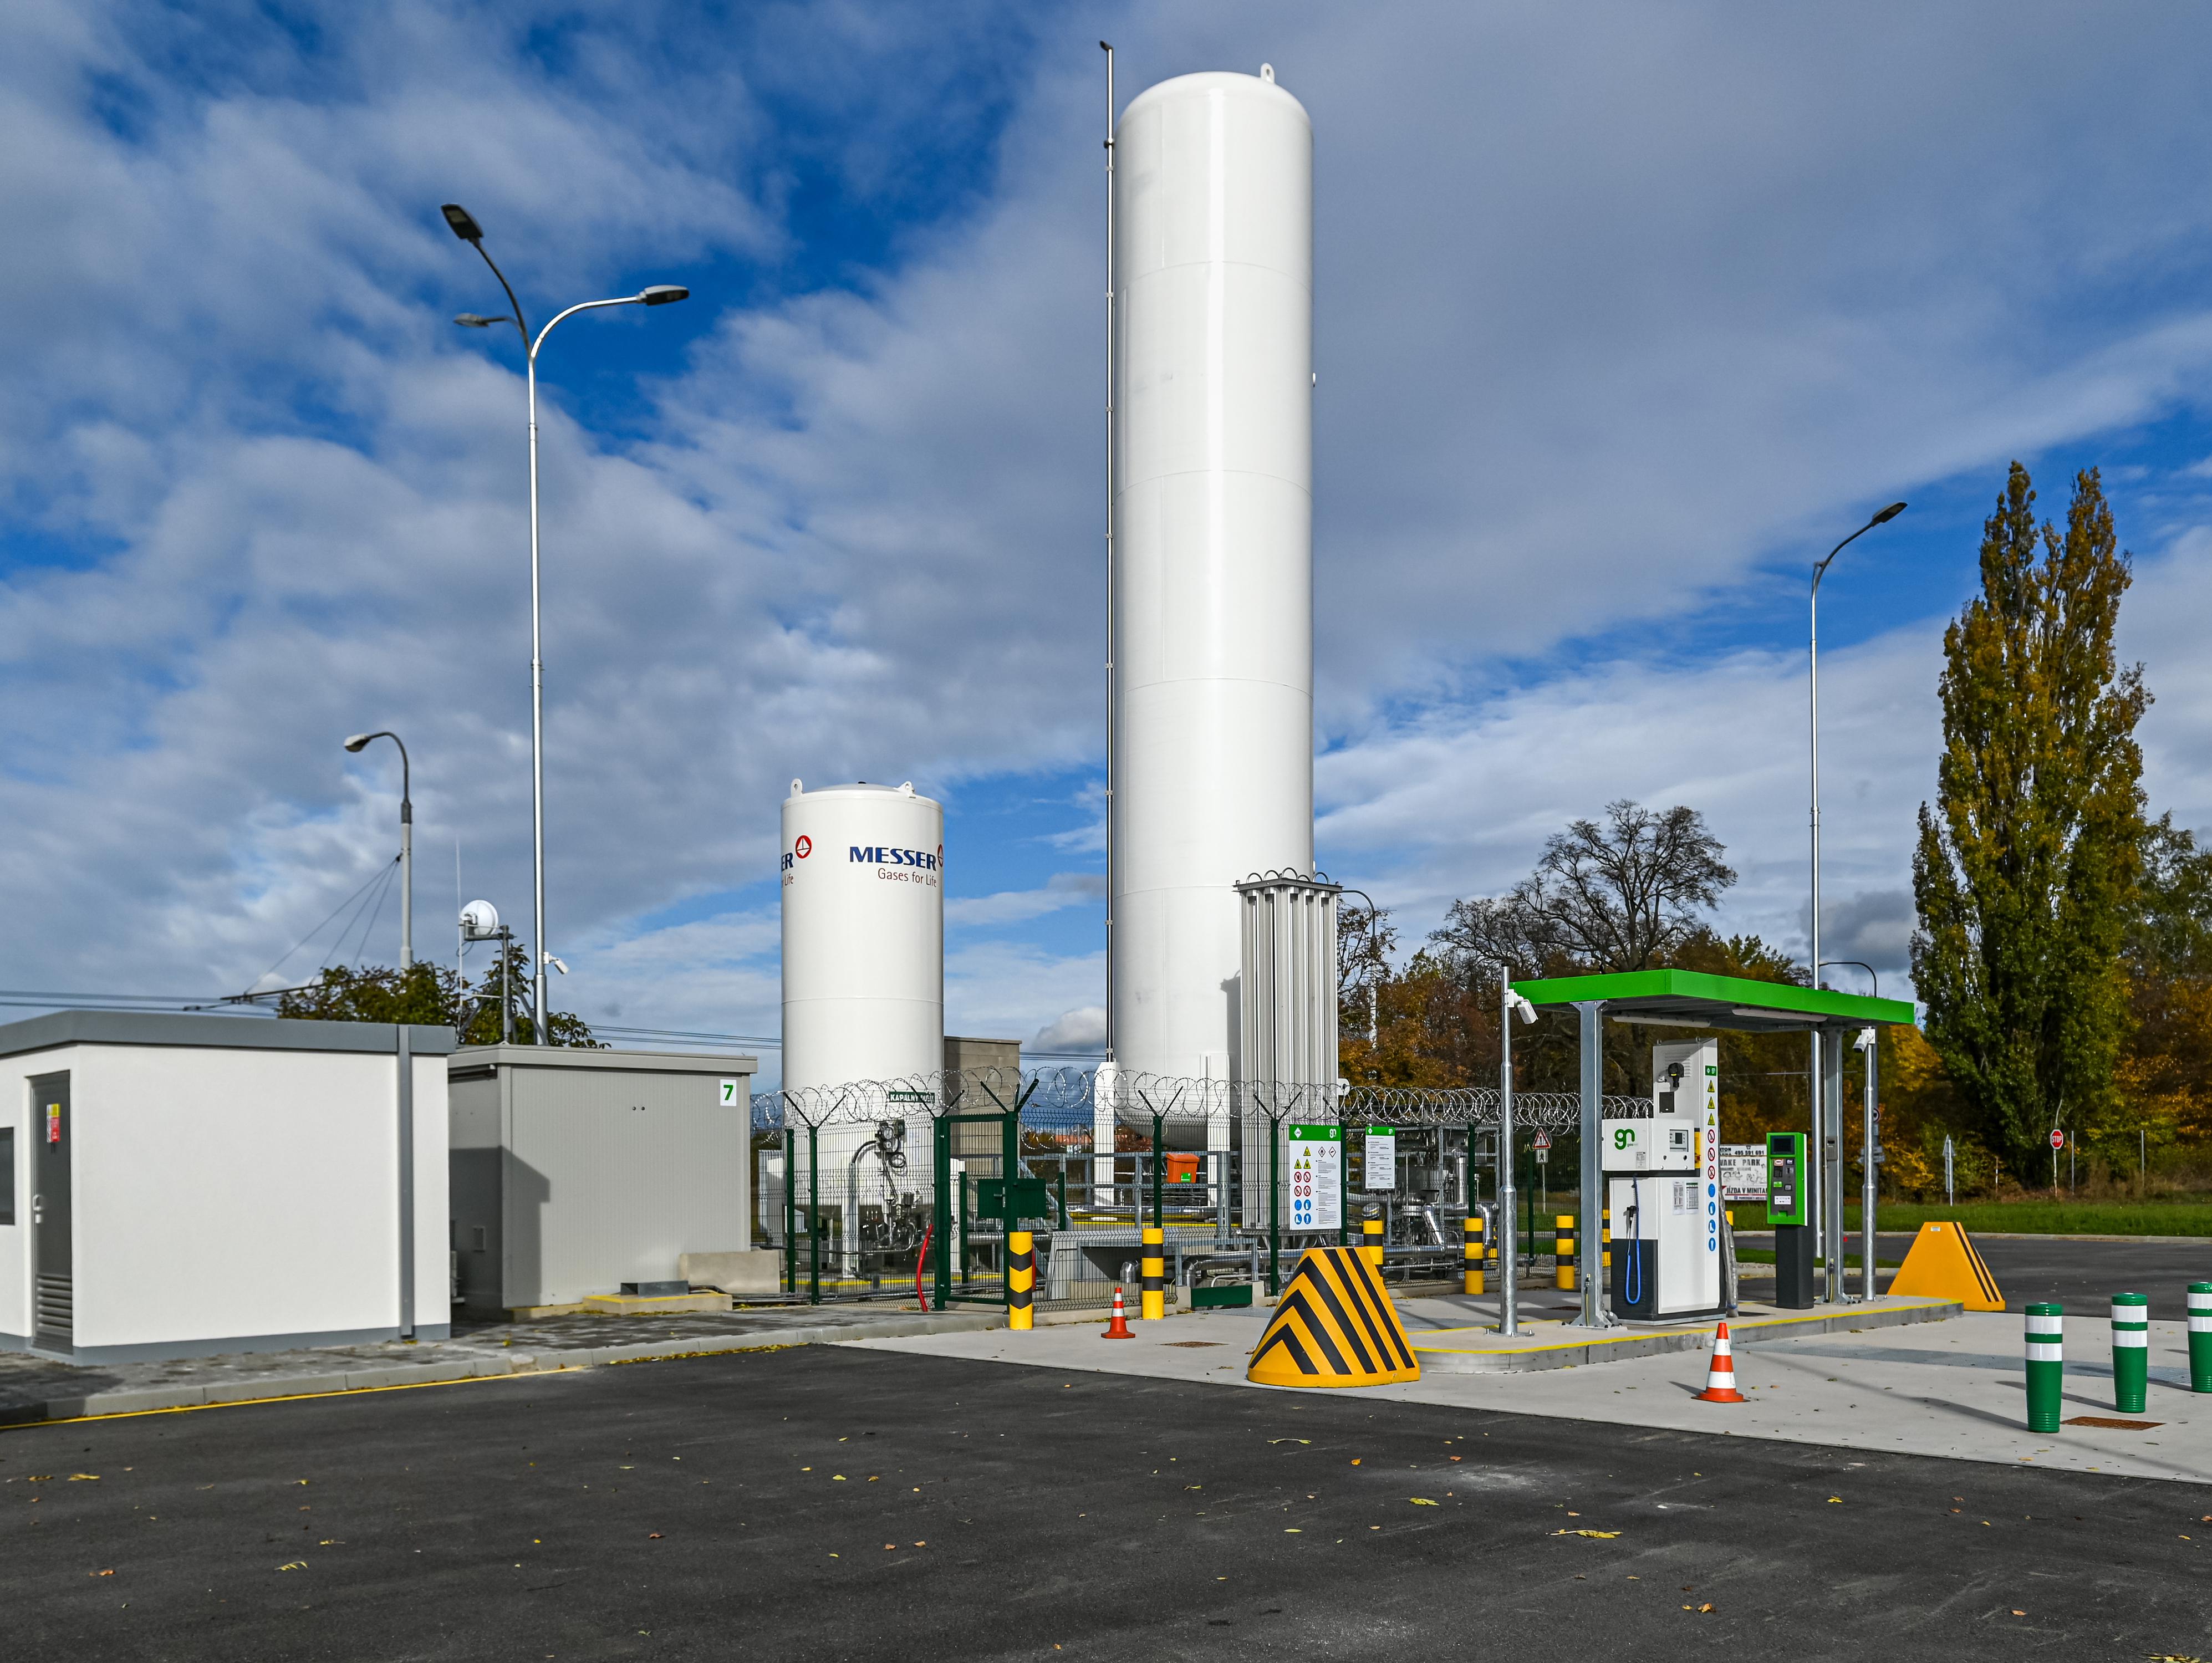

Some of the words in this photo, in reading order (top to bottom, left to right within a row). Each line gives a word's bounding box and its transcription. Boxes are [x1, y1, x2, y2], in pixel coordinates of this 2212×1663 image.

[849, 846, 937, 872] MESSER
[784, 874, 794, 886] Life
[878, 868, 909, 881] Gases
[912, 871, 924, 884] for
[926, 874, 937, 887] Life
[723, 1084, 733, 1100] 7
[1614, 1129, 1635, 1150] gn
